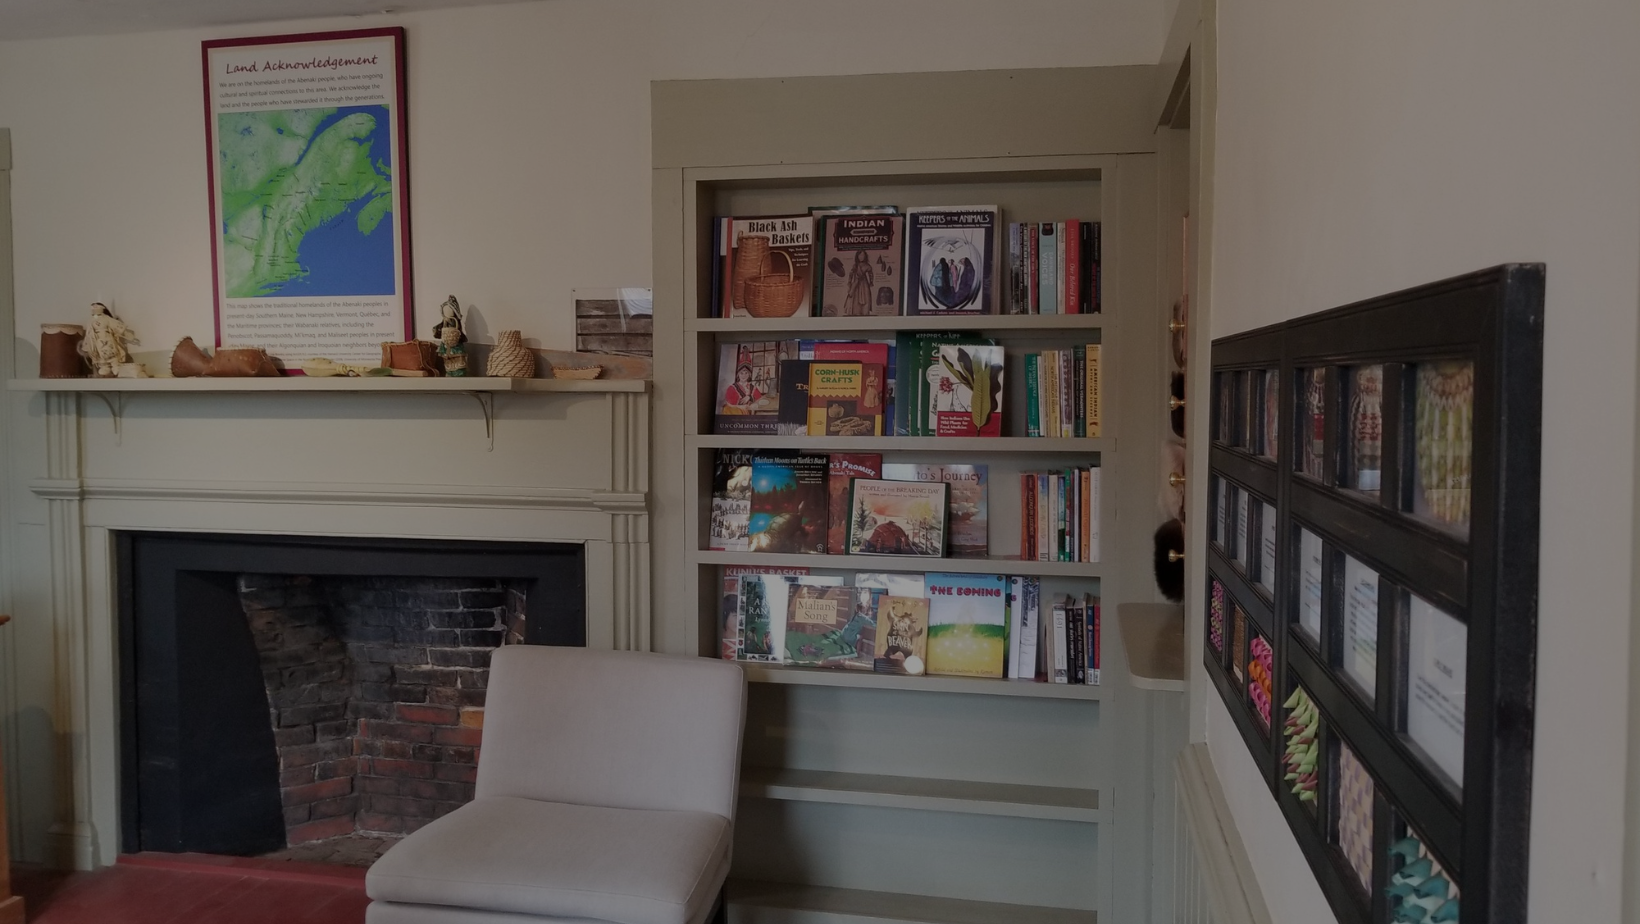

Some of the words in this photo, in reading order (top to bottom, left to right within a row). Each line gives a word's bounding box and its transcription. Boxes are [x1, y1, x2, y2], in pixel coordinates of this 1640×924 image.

[226, 61, 258, 74] Land
[262, 55, 378, 71] Acknowledgement
[844, 219, 885, 228] INDIAN
[919, 215, 945, 223] KEEPERS
[959, 215, 989, 223] ANIMALS
[748, 220, 777, 232] Black
[781, 220, 797, 231] Ash
[772, 233, 810, 244] Baskets
[842, 461, 876, 477] PROMISE
[916, 467, 936, 480] to's
[940, 468, 982, 485] Journey
[930, 585, 953, 595] THE
[957, 587, 1001, 597] COMING
[798, 600, 836, 611] Malian's
[804, 611, 828, 623] Song
[888, 636, 913, 649] BEAVER
